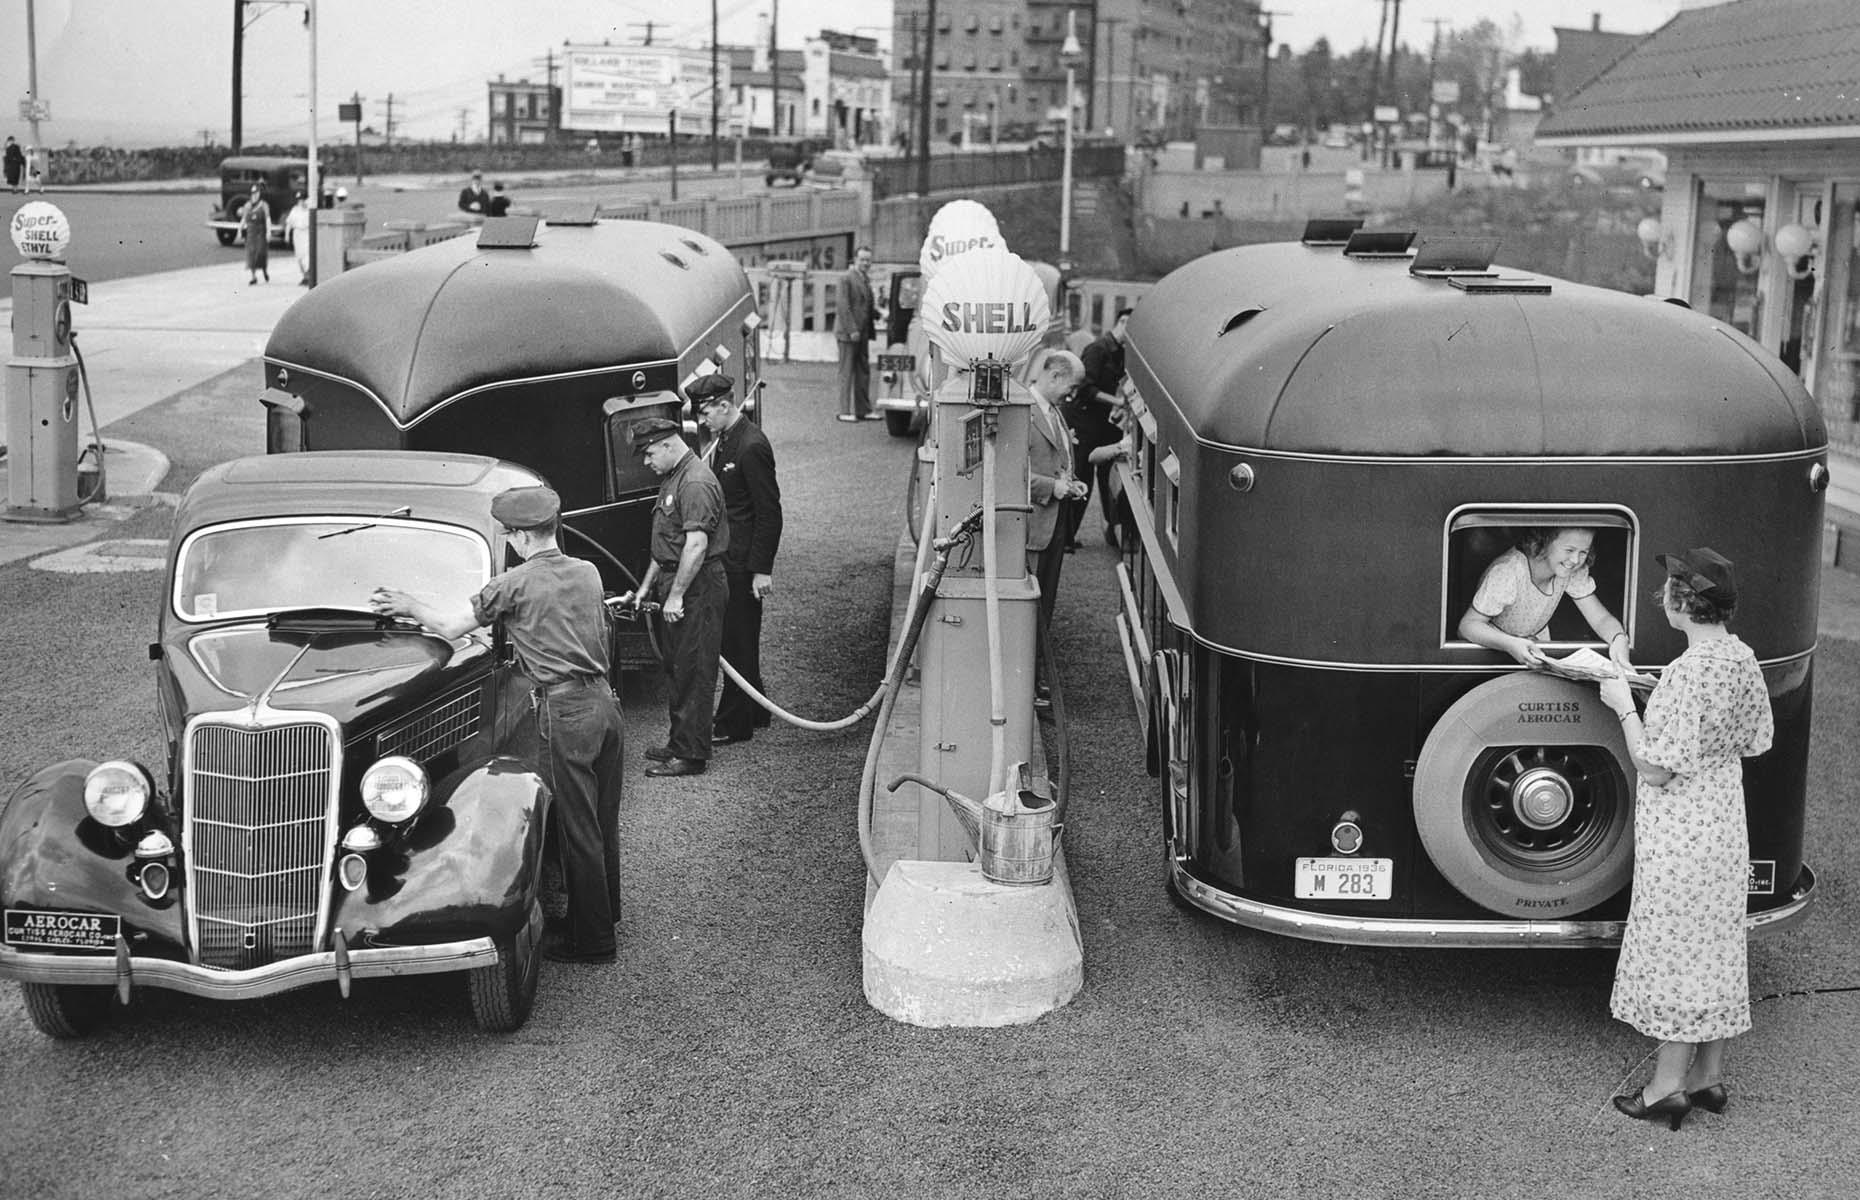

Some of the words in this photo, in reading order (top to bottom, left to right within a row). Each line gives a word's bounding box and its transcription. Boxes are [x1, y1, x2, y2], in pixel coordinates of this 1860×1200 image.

[14, 213, 59, 232] Super-
[24, 230, 59, 241] SHELL
[20, 242, 52, 254] ETHYL
[942, 302, 1037, 333] SHELL
[1518, 702, 1580, 711] CURTISS
[1517, 714, 1581, 723] AEROCAR
[1314, 874, 1325, 892] M
[1338, 873, 1374, 894] 283
[24, 915, 102, 931] AEROCAR
[48, 930, 87, 938] AEROCAR
